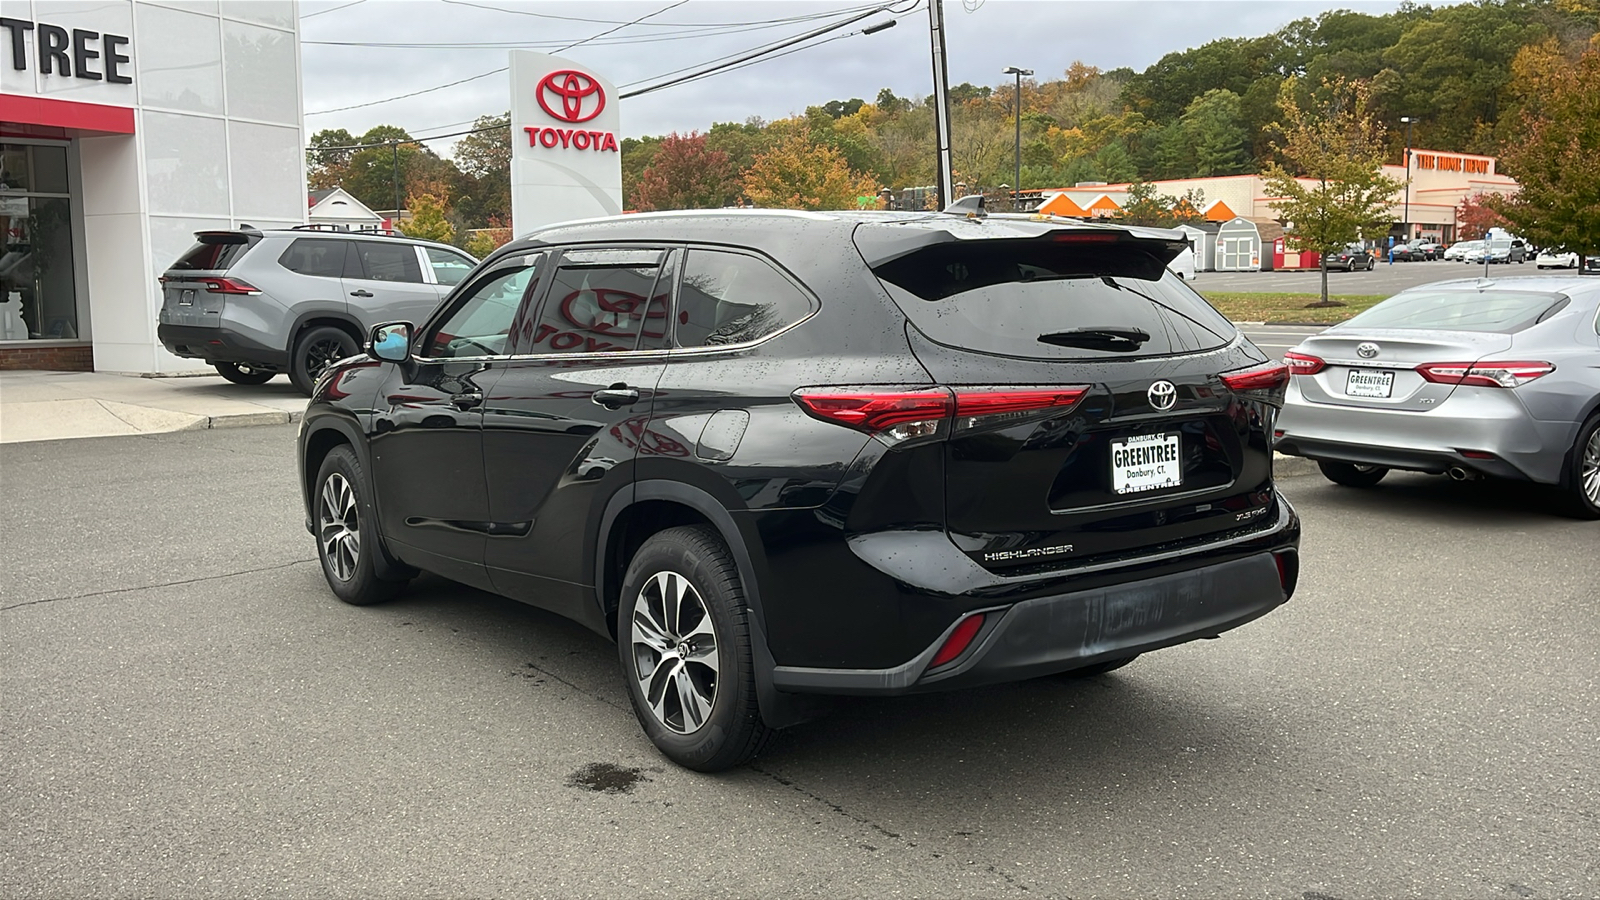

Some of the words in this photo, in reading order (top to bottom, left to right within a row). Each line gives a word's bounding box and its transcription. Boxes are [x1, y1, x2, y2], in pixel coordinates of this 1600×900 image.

[0, 17, 132, 84] TREE
[523, 127, 618, 152] TOYOTA
[1417, 154, 1434, 169] THE
[1437, 156, 1461, 171] HOME
[1464, 158, 1489, 174] DEPOT
[1350, 375, 1390, 386] GREENTREE
[1115, 444, 1176, 468] GREENTREE
[1127, 467, 1156, 479] Danbury,
[1157, 465, 1167, 475] CT.
[984, 544, 1074, 561] HIGHLANDER
